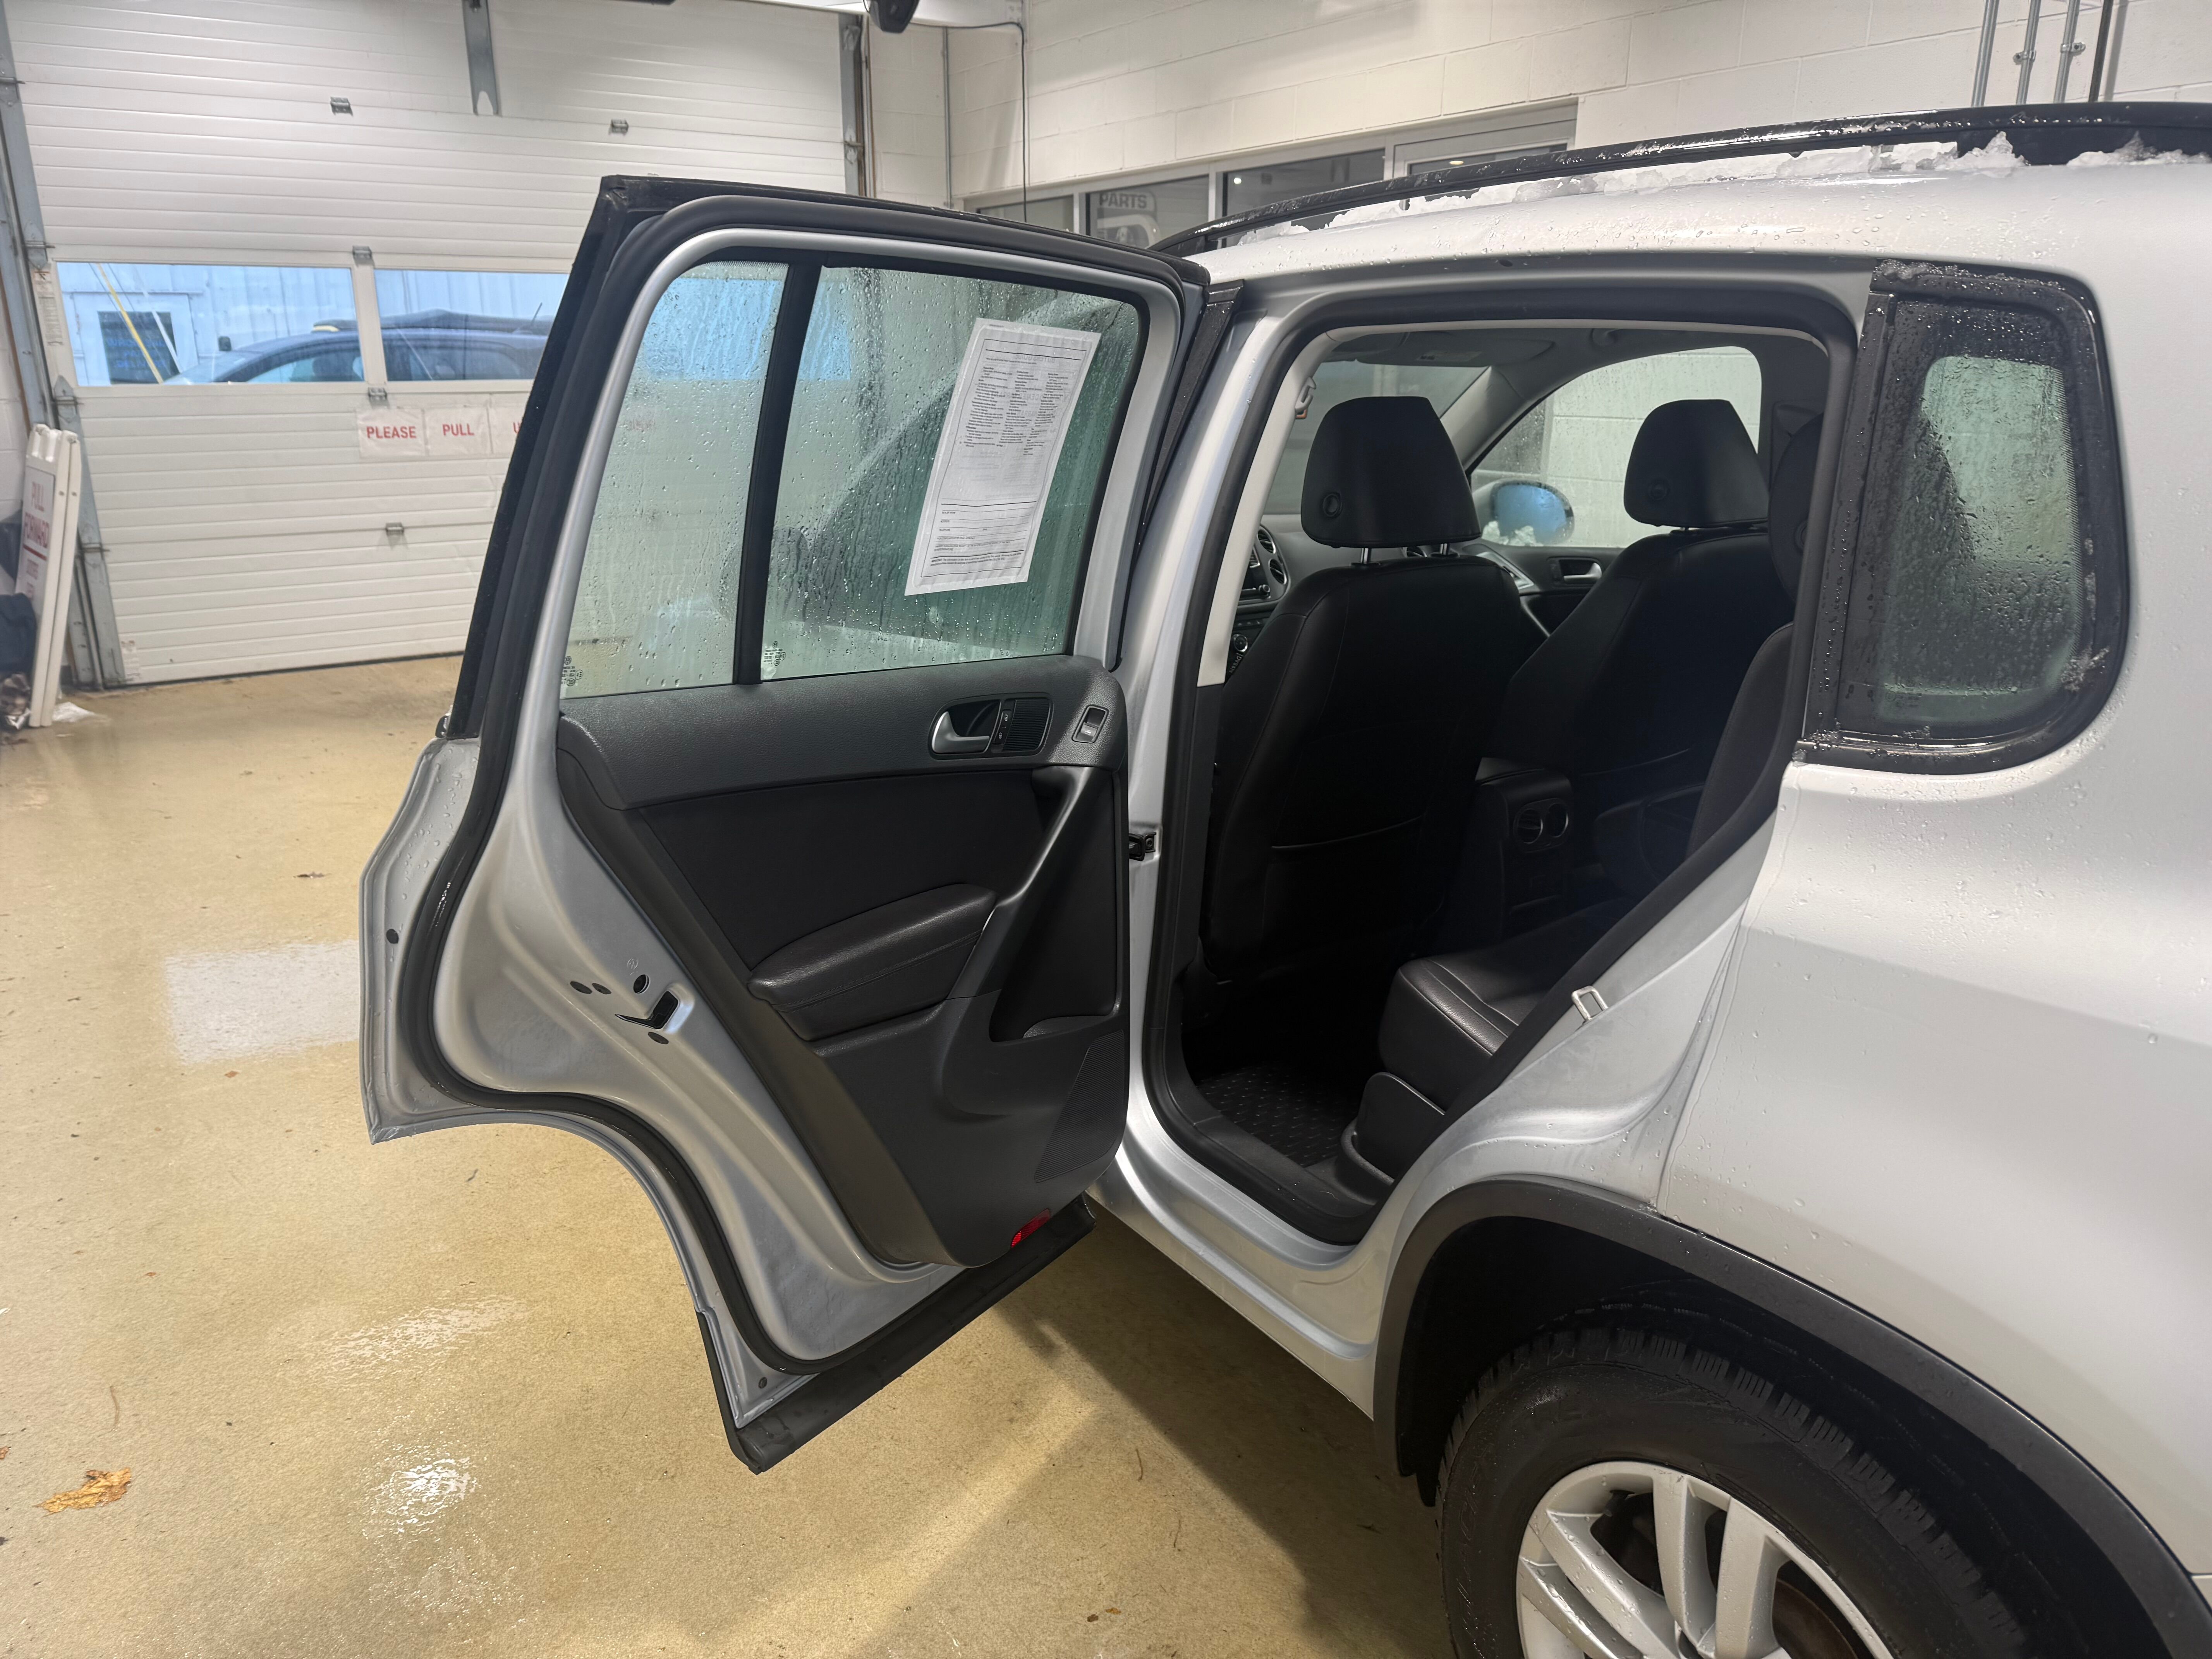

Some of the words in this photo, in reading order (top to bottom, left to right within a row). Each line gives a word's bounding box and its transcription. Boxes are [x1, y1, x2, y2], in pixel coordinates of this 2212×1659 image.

[1099, 193, 1147, 209] PARTS
[366, 426, 417, 439] PLEASE
[442, 423, 475, 436] PULL
